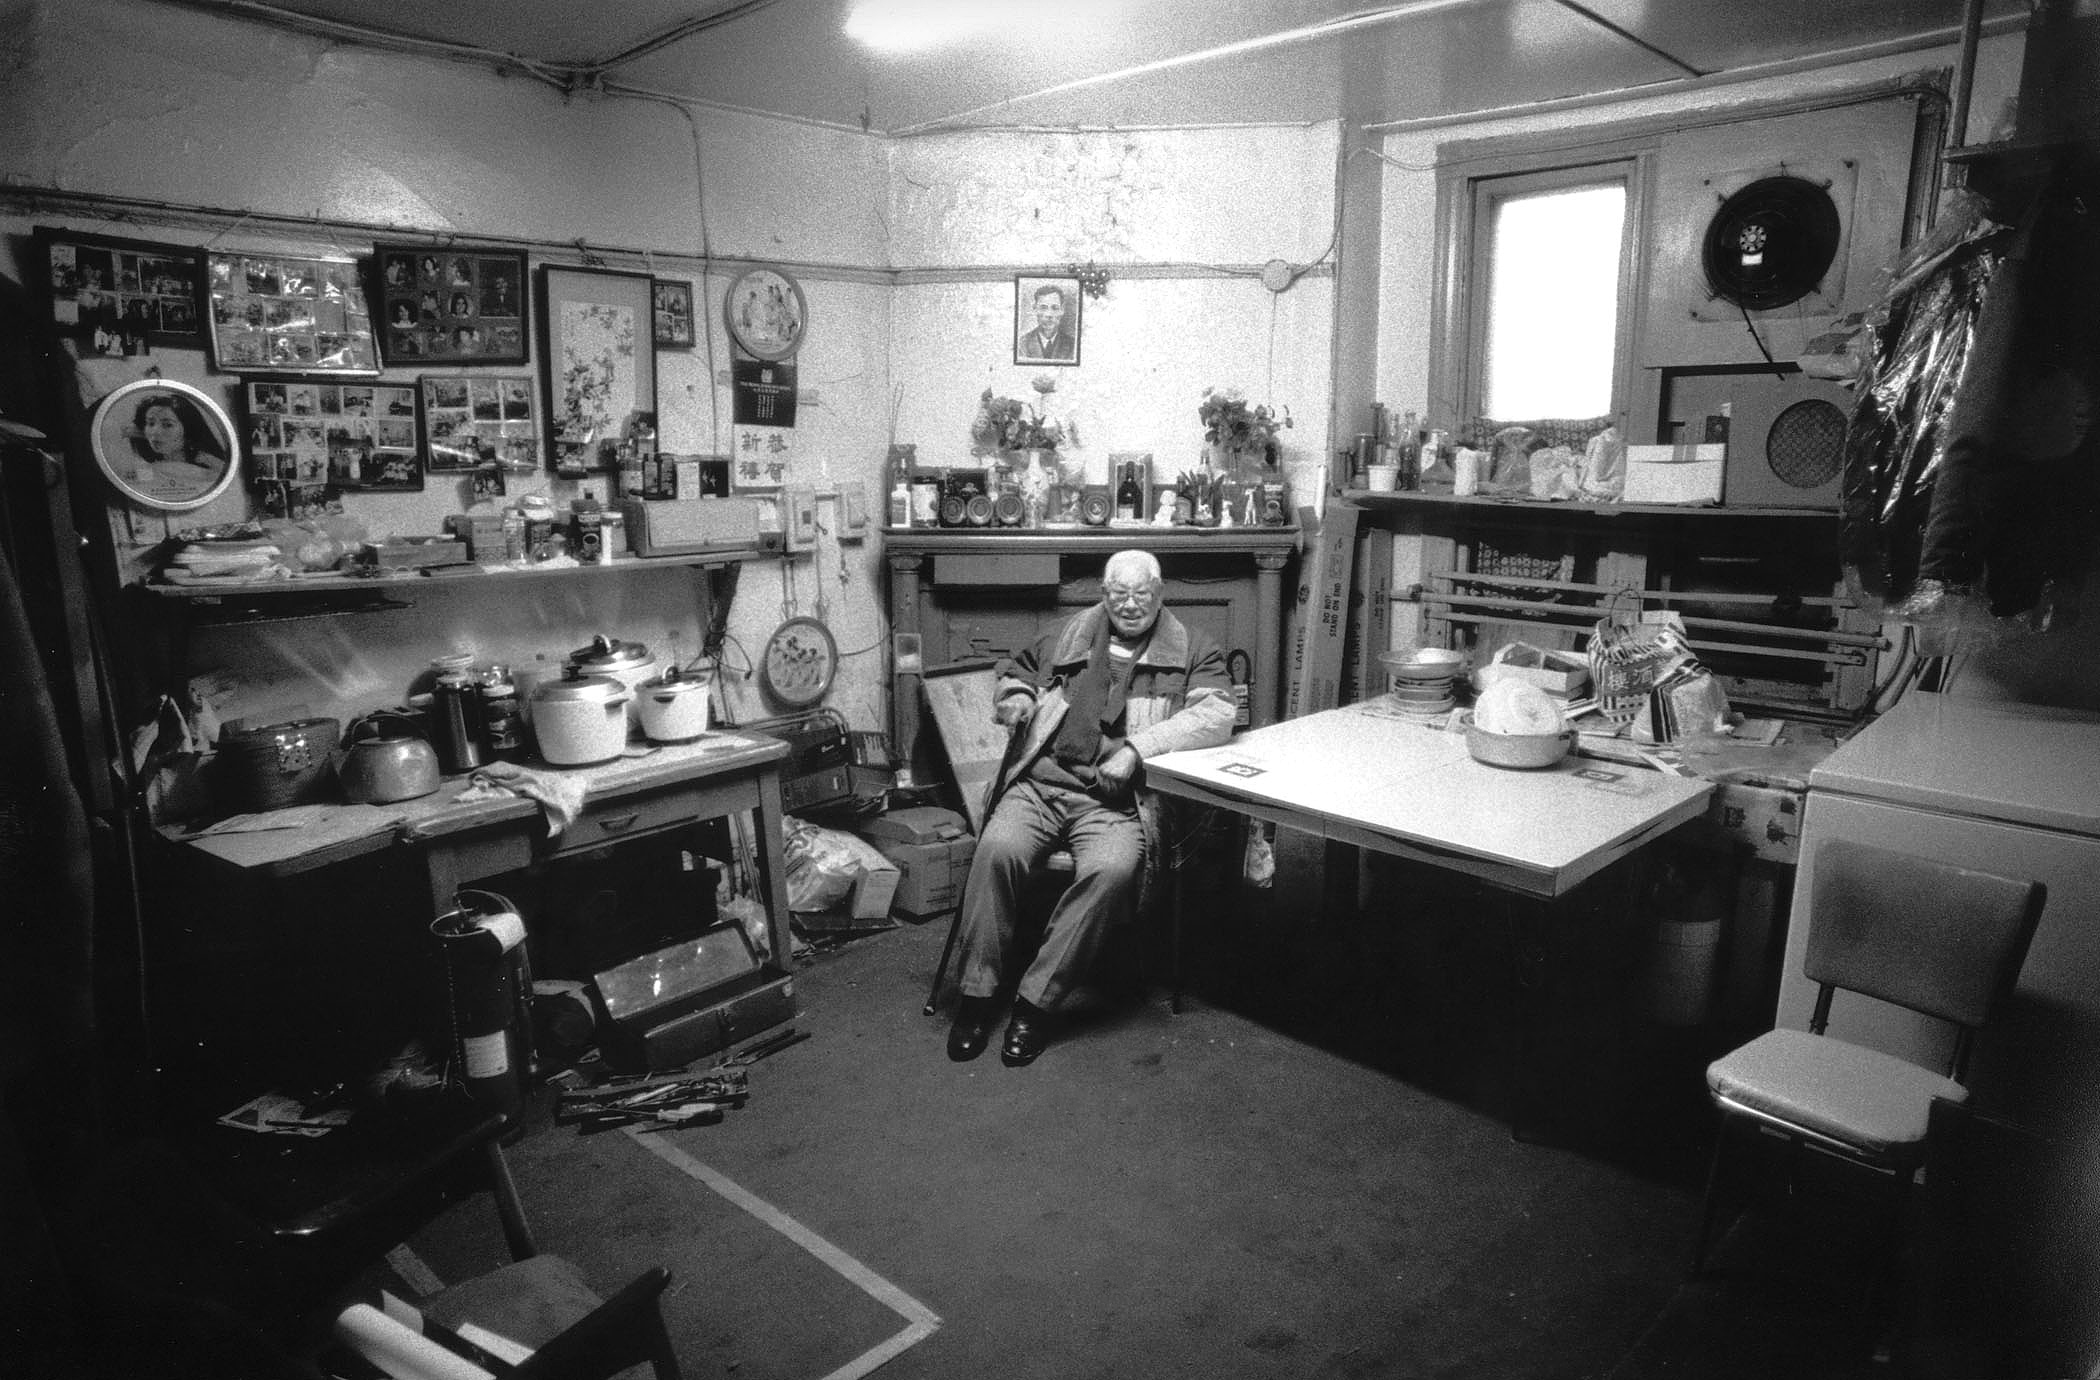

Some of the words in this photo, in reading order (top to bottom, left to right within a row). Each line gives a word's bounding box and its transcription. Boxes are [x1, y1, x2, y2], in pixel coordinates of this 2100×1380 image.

[1333, 583, 1341, 598] END
[1333, 600, 1340, 611] ON
[1323, 612, 1331, 624] DO
[1329, 614, 1338, 638] STAND
[1295, 626, 1305, 671] LAMPS
